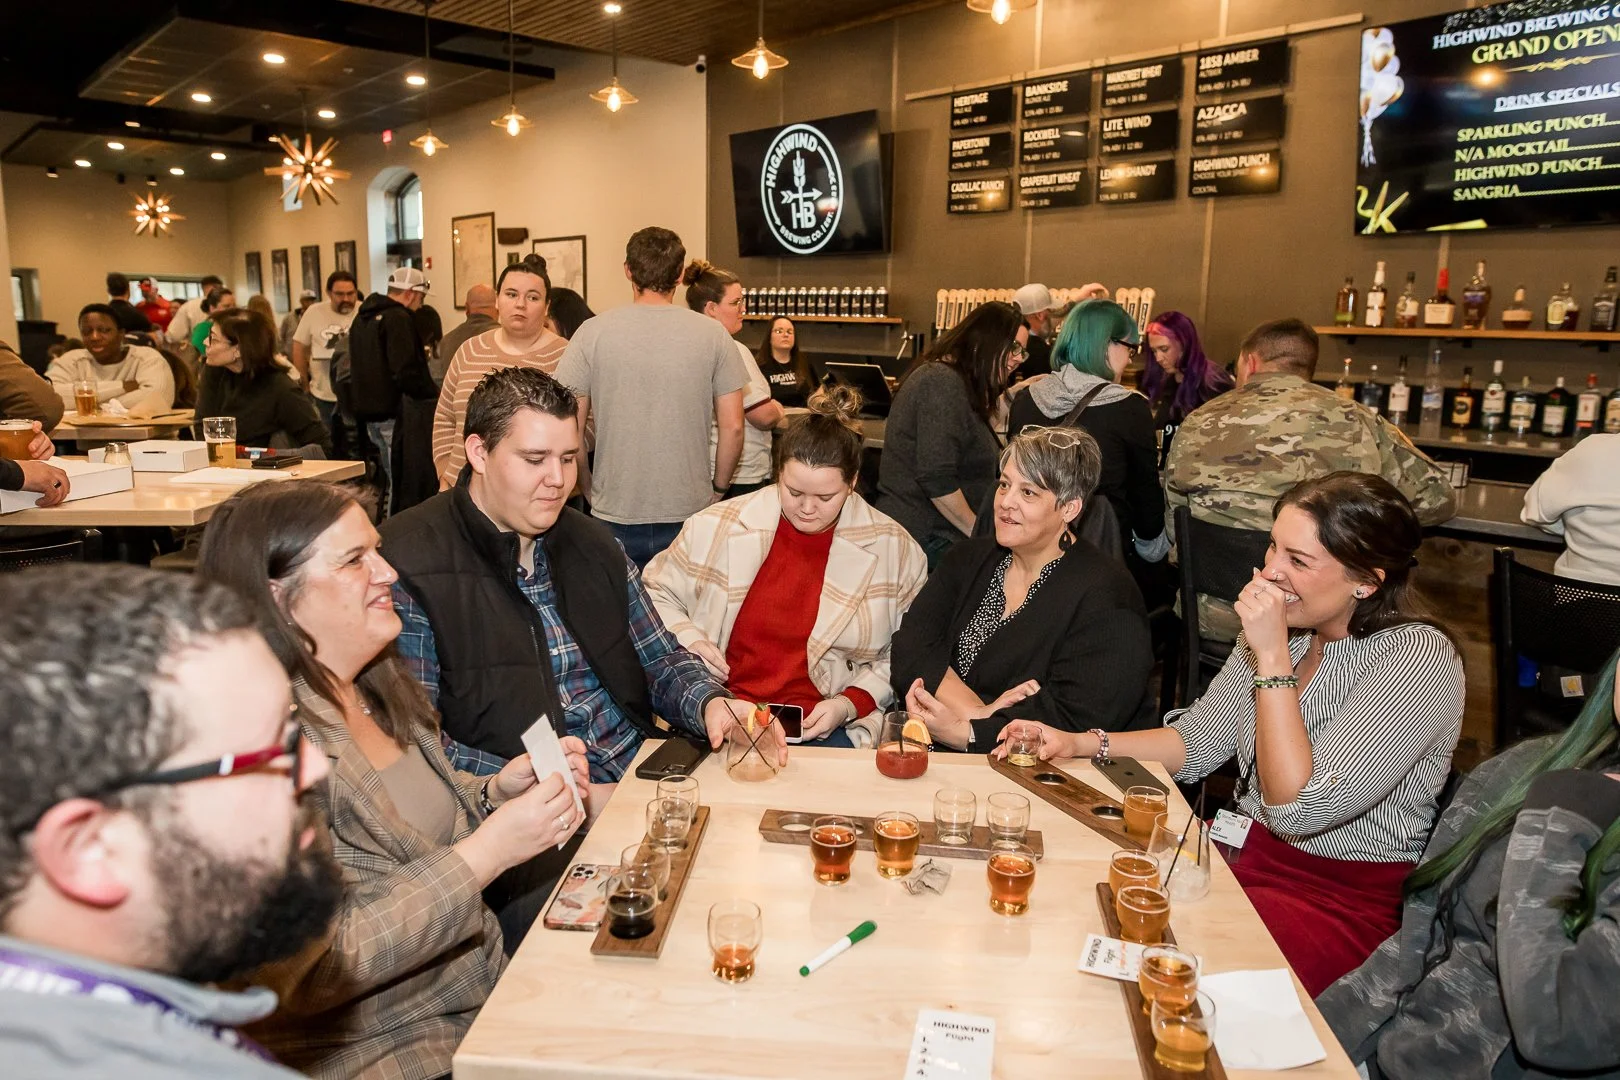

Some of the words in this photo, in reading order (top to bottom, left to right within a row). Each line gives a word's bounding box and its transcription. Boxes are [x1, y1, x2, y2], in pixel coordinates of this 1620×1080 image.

[1432, 22, 1523, 50] HIGHWIND
[1524, 7, 1610, 36] BREWING
[1223, 48, 1260, 66] AMBER
[1471, 35, 1550, 64] GRAND
[1025, 80, 1069, 98] BANKSIDE
[1494, 92, 1546, 111] DRINK
[1546, 81, 1620, 103] SPECIALS
[953, 91, 989, 108] HERITAGE
[1196, 102, 1247, 121] AZACCA
[1103, 119, 1124, 132] LITE
[1124, 114, 1152, 130] WIND
[1457, 119, 1543, 142] SPARKLING
[1544, 112, 1607, 133] PUNCH
[1024, 128, 1061, 142] ROCKWELL
[766, 132, 818, 188] HIGHWIND
[1454, 146, 1485, 163] N/A
[1486, 138, 1570, 159] MOCKTAIL
[1194, 157, 1238, 172] HIGHWIND
[1239, 152, 1271, 168] PUNCH
[1454, 162, 1540, 182] HIGHWIND
[1541, 156, 1603, 175] PUNCH
[951, 182, 981, 193] CADILLAC
[981, 180, 1005, 191] RANCH
[1453, 184, 1521, 201] SANGRIA
[791, 201, 817, 229] HB
[779, 225, 812, 246] BREWING
[1085, 938, 1102, 968] HIGHWIND
[933, 1021, 990, 1033] HIGHWIND
[945, 1032, 975, 1043] Flight
